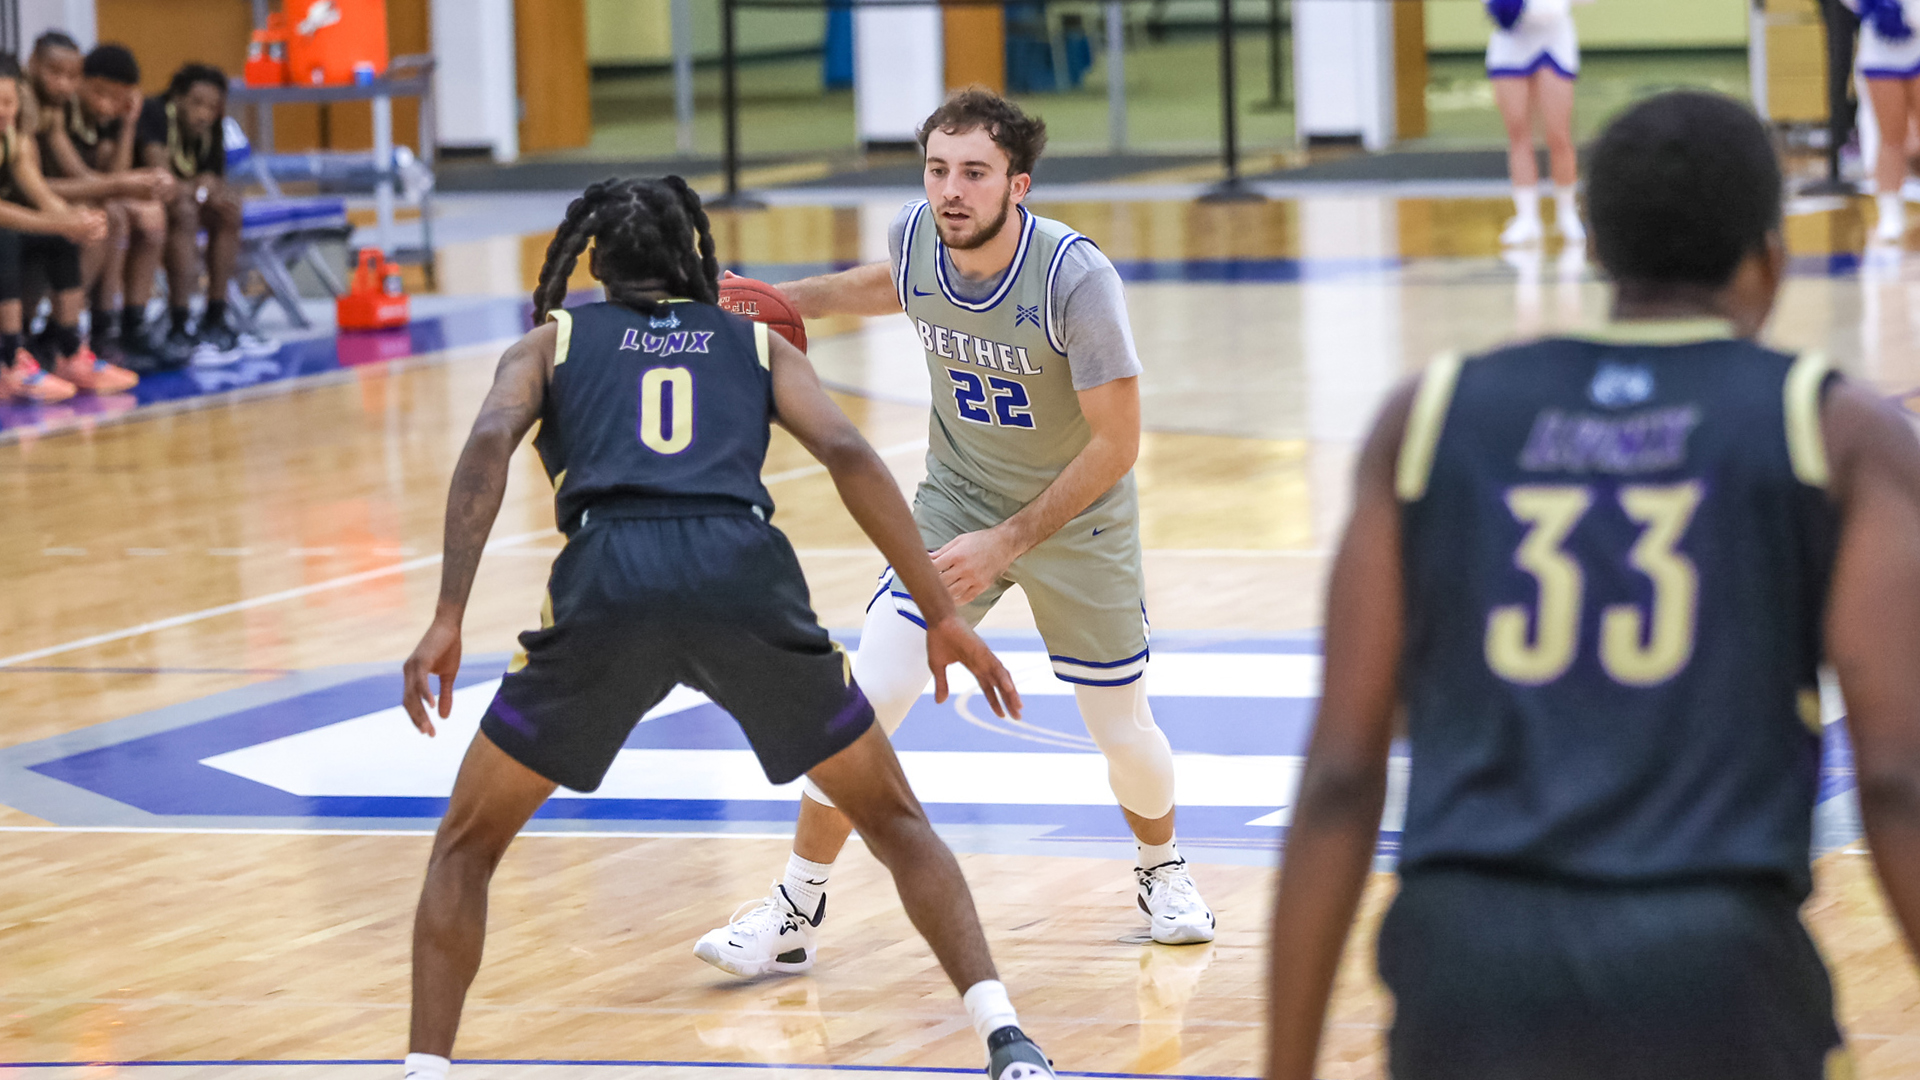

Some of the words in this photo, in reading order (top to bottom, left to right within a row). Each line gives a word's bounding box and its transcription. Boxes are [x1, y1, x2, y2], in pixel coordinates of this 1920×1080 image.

[619, 328, 714, 357] LYNX
[917, 317, 1043, 375] BETHEL
[638, 365, 696, 457] 0
[944, 366, 1036, 430] 22
[1484, 482, 1706, 687] 33
